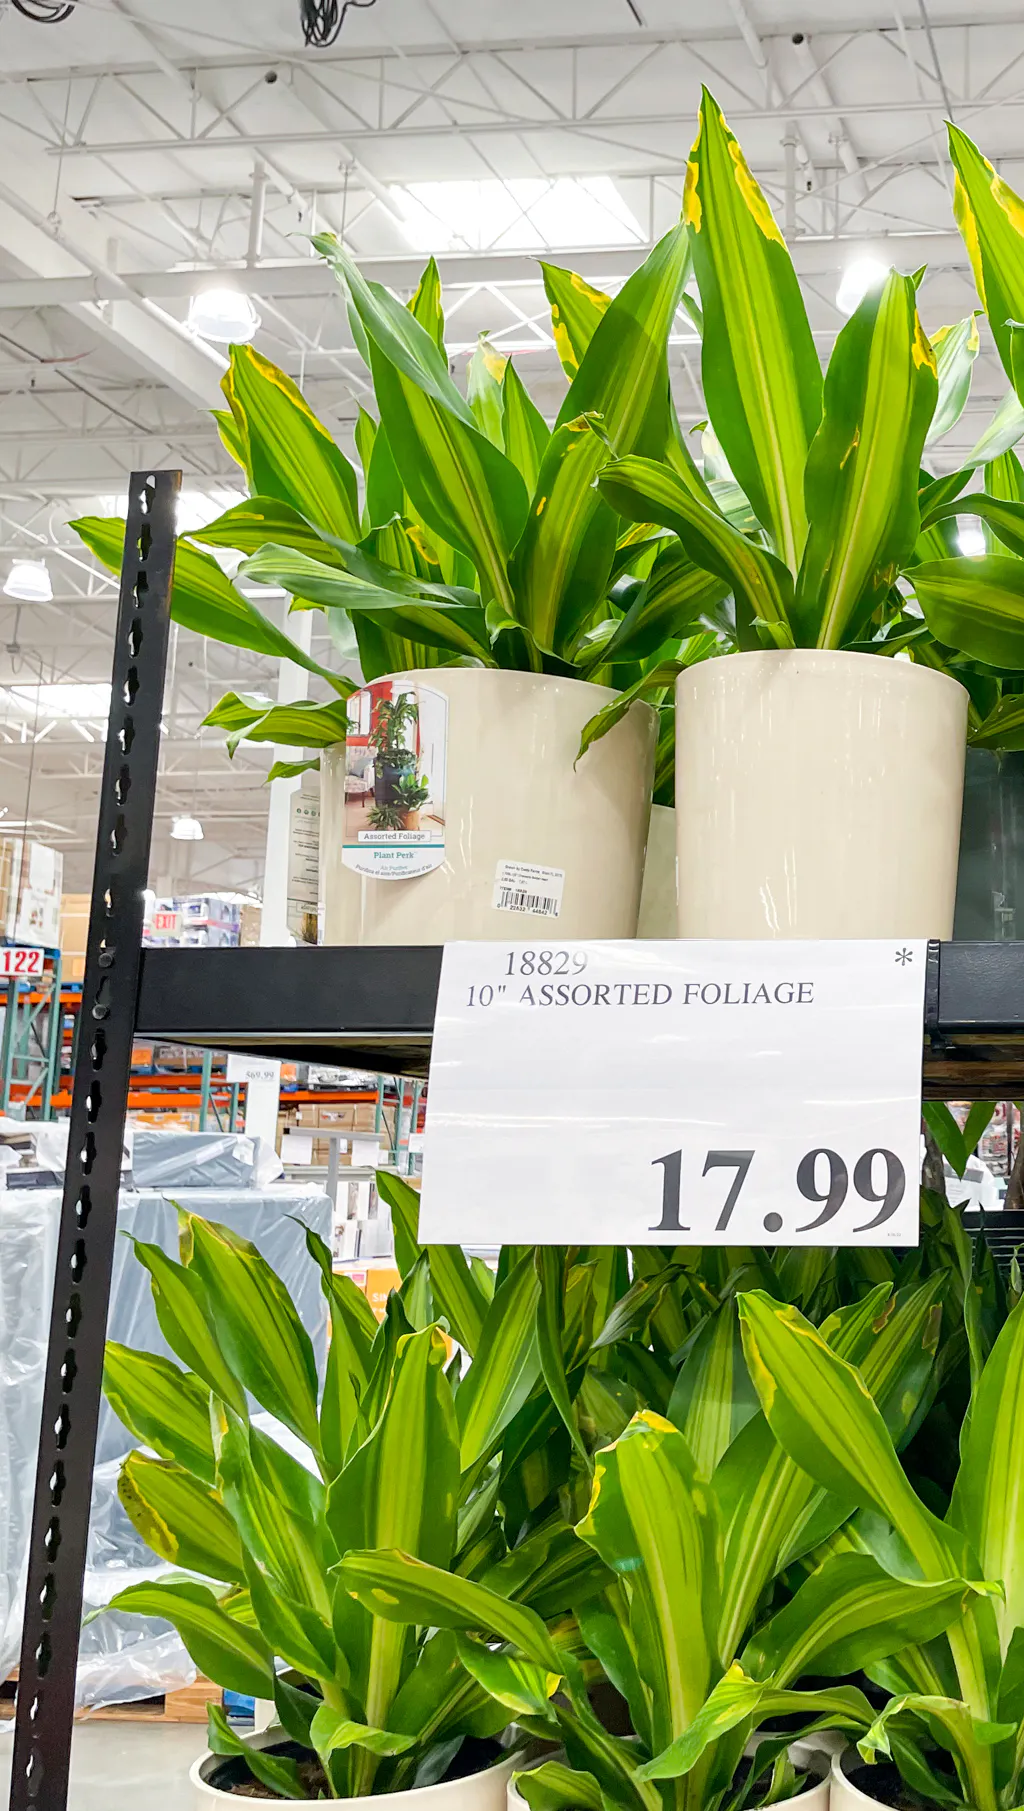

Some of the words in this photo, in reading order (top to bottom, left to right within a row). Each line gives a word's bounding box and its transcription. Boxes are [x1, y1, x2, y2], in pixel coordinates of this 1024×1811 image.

[398, 833, 426, 841] Foliage
[155, 913, 177, 929] EXIT
[3, 951, 40, 973] 122
[504, 950, 589, 976] 18829
[466, 984, 507, 1007] 10"
[519, 983, 673, 1006] ASSORTED
[682, 982, 815, 1005] FOLIAGE
[647, 1148, 907, 1234] 17.99
